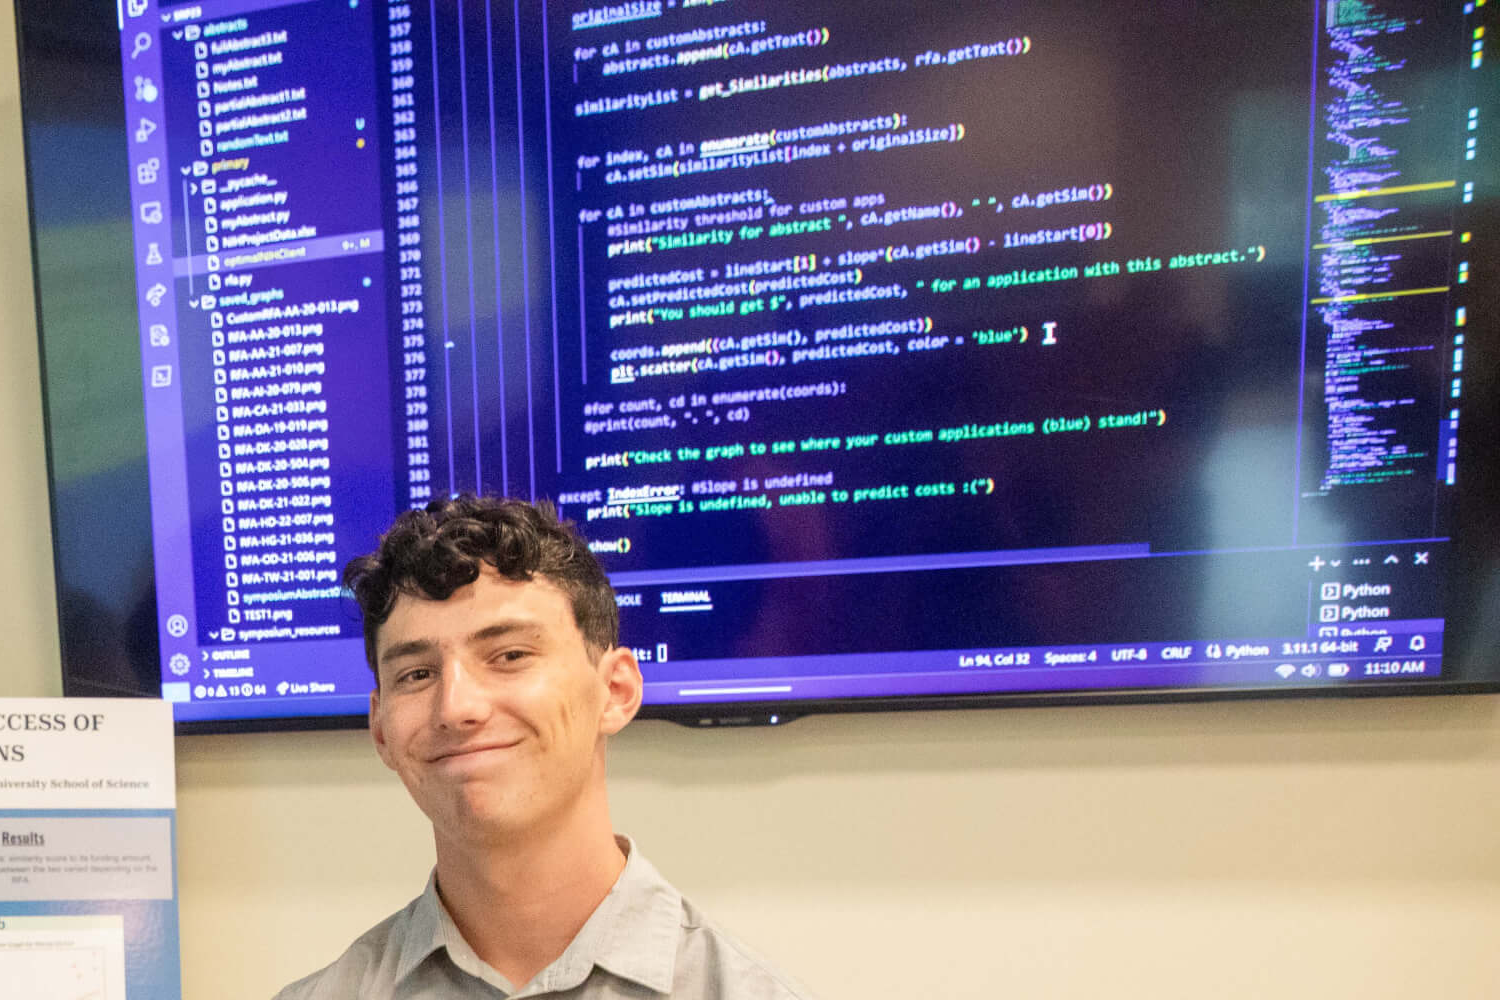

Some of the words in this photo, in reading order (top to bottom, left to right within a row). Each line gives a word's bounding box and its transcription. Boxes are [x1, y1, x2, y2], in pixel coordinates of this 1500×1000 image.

[573, 0, 660, 24] originalSize
[574, 45, 595, 61] for
[603, 40, 617, 57] cA
[625, 37, 639, 54] in
[647, 19, 765, 50] customAbstracts:
[603, 27, 828, 75] abstracts.append(cA.getText())
[575, 87, 677, 116] similarityList
[916, 36, 1029, 68] rfa.getText())
[577, 154, 598, 170] for
[606, 149, 647, 166] index,
[656, 143, 670, 160] cA
[678, 141, 692, 157] in
[606, 143, 829, 184] cA.setSim(similarityList[index
[853, 123, 963, 153] originalSize])
[695, 205, 761, 228] threshold
[769, 203, 791, 219] for
[800, 197, 845, 216] custom
[853, 194, 884, 211] apps
[739, 225, 761, 241] for
[769, 215, 829, 238] abstract
[861, 201, 961, 227] cA.getName(),
[1013, 182, 1111, 210] cA.getSim())
[609, 267, 702, 294] predictedCost
[1004, 221, 1111, 249] lineStart[0])
[609, 268, 861, 309] cA.setPredictedCost(predictedCost)
[610, 307, 681, 330] print("You
[689, 300, 732, 319] should
[740, 297, 762, 316] get
[800, 282, 906, 310] predictedCost,
[932, 278, 955, 294] for
[964, 277, 979, 291] an
[988, 265, 1077, 290] application
[1086, 259, 1118, 278] with
[1128, 255, 1161, 274] this
[1170, 244, 1264, 269] abstract.")
[403, 334, 424, 348] 375
[611, 329, 806, 362] coords.append((cA.getSim(),
[816, 316, 931, 345] predictedCost))
[793, 338, 898, 365] predictedCost,
[908, 335, 947, 352] color
[972, 325, 1027, 345] 'blue')
[405, 368, 426, 382] 377
[712, 380, 844, 406] enumerate(coords):
[585, 448, 669, 471] print("Check
[677, 446, 698, 461] the
[706, 442, 742, 462] graph
[750, 441, 764, 456] to
[772, 441, 794, 454] see
[802, 436, 839, 452] where
[847, 434, 877, 451] your
[885, 428, 931, 445] custom
[940, 420, 1034, 443] applications
[1043, 413, 1091, 435] (blue)
[1100, 407, 1166, 428] stand!")
[558, 488, 599, 506] except
[607, 484, 683, 501] IndexError:
[743, 477, 757, 491] is
[765, 470, 831, 490] undefined
[587, 501, 670, 523] print("Slope
[678, 499, 692, 514] is
[700, 493, 770, 512] undefined,
[780, 489, 824, 506] unable
[832, 488, 847, 503] to
[855, 483, 908, 504] predict
[916, 480, 954, 497] costs
[1342, 583, 1391, 600] Python
[1341, 605, 1390, 622] Python
[994, 653, 1014, 666] Col
[1015, 652, 1030, 665] 32
[1044, 652, 1086, 666] Spaces:
[1111, 648, 1148, 662] UTF-8
[1160, 646, 1193, 660] CRLF
[1225, 644, 1270, 660] Python
[1282, 642, 1318, 655] 3.11.1
[1319, 640, 1358, 653] 64-bit
[1364, 662, 1399, 675] 11:10
[1401, 660, 1426, 674] AM
[74, 713, 106, 733] OF
[50, 779, 88, 790] School
[91, 779, 103, 790] of
[105, 779, 149, 790] Science
[2, 831, 45, 845] Results
